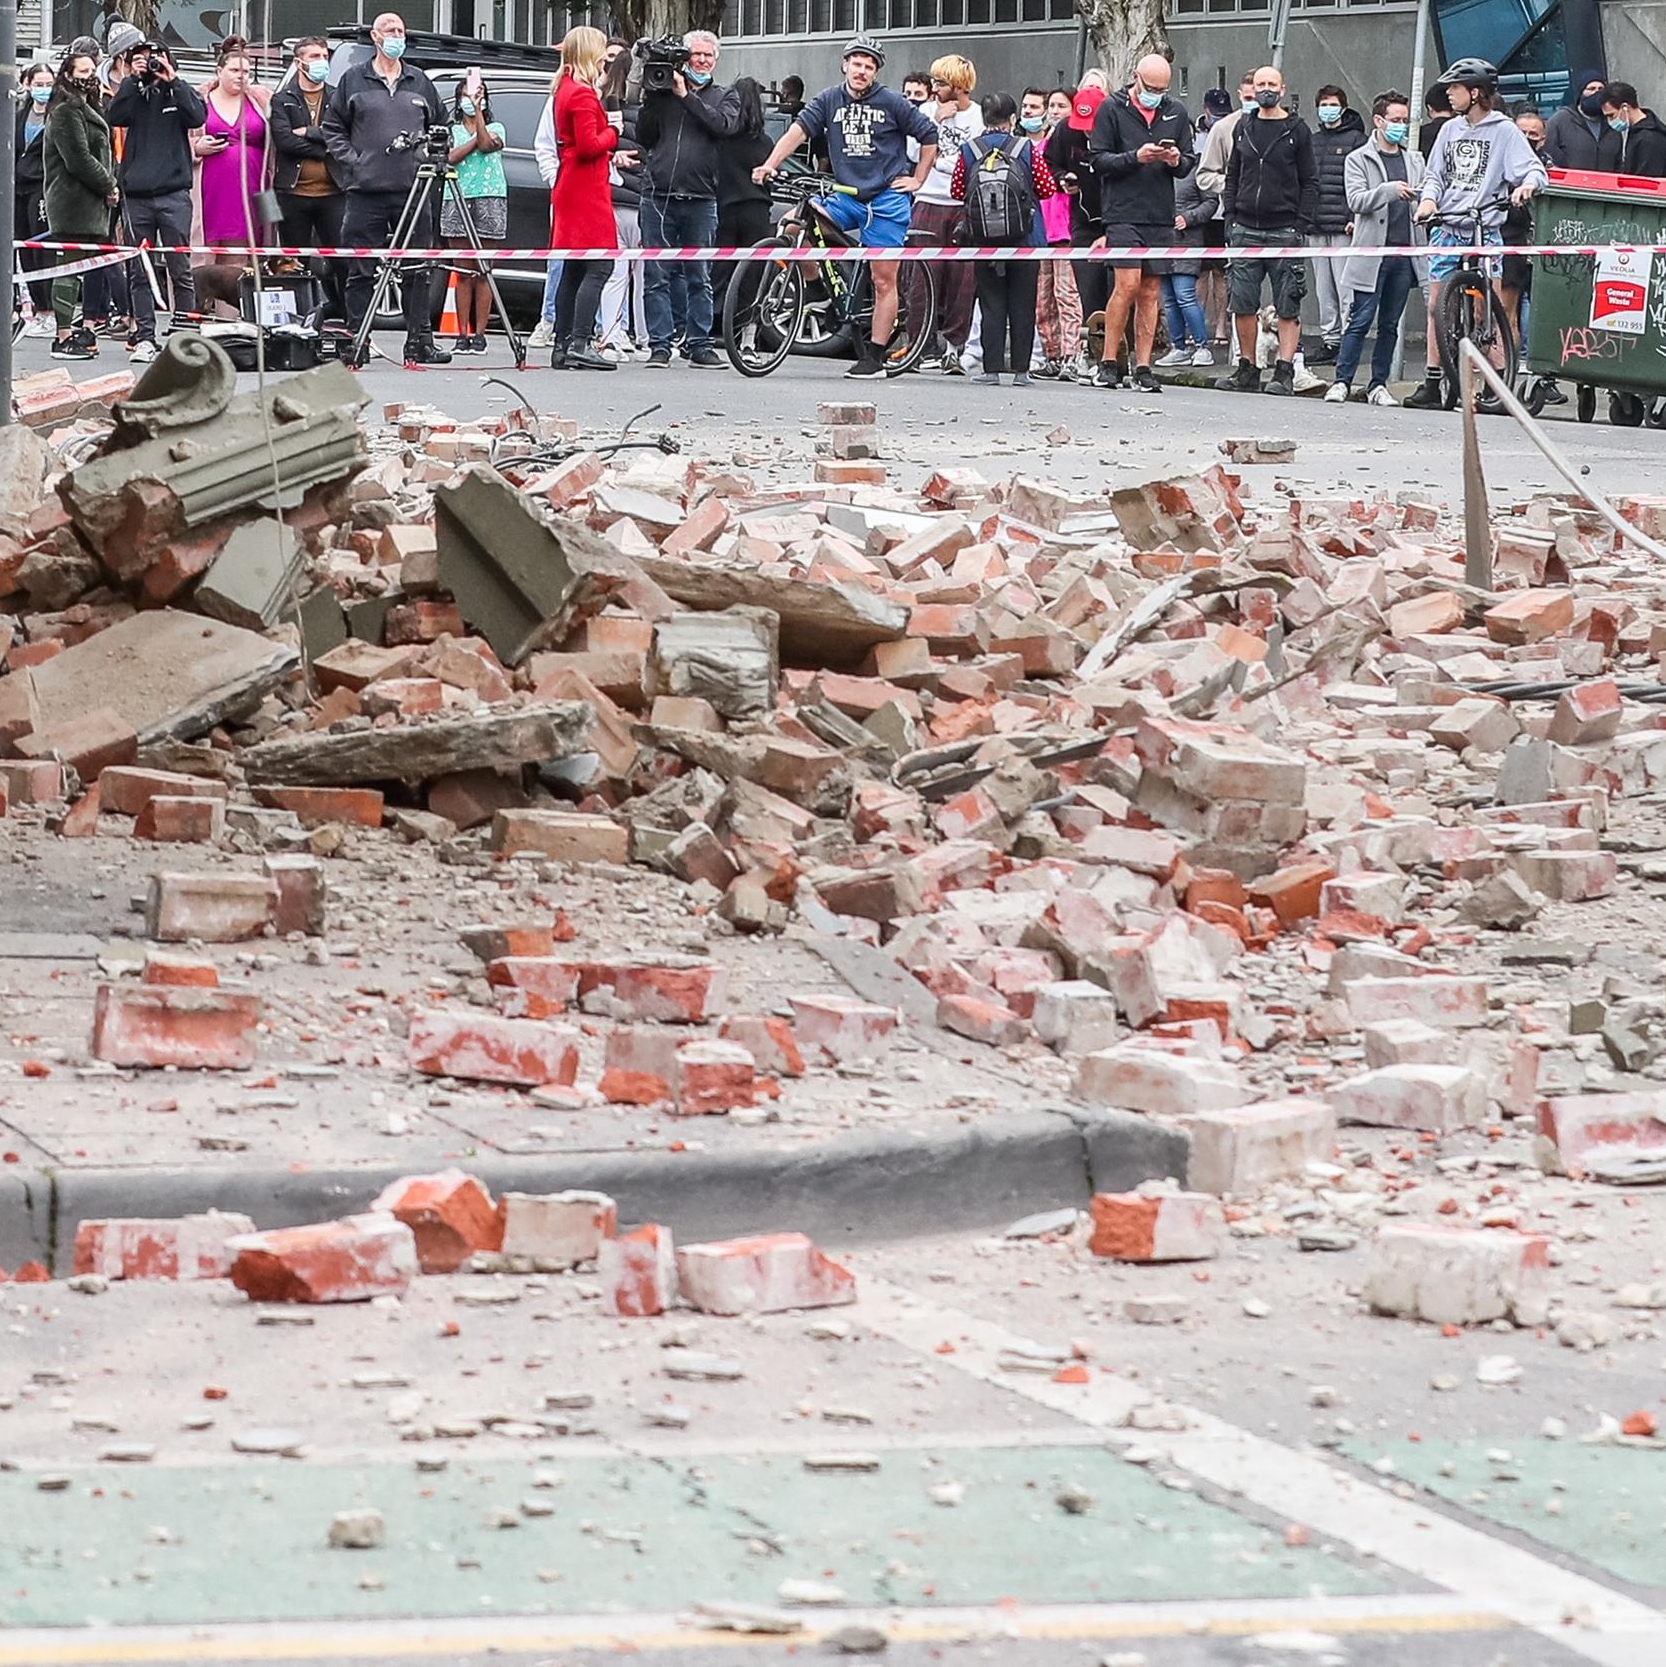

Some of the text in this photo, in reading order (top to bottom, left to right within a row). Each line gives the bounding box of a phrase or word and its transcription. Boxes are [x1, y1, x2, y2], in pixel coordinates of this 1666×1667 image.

[1609, 265, 1636, 273] VEOLIA
[1606, 287, 1635, 298] General
[1608, 296, 1631, 306] Waste
